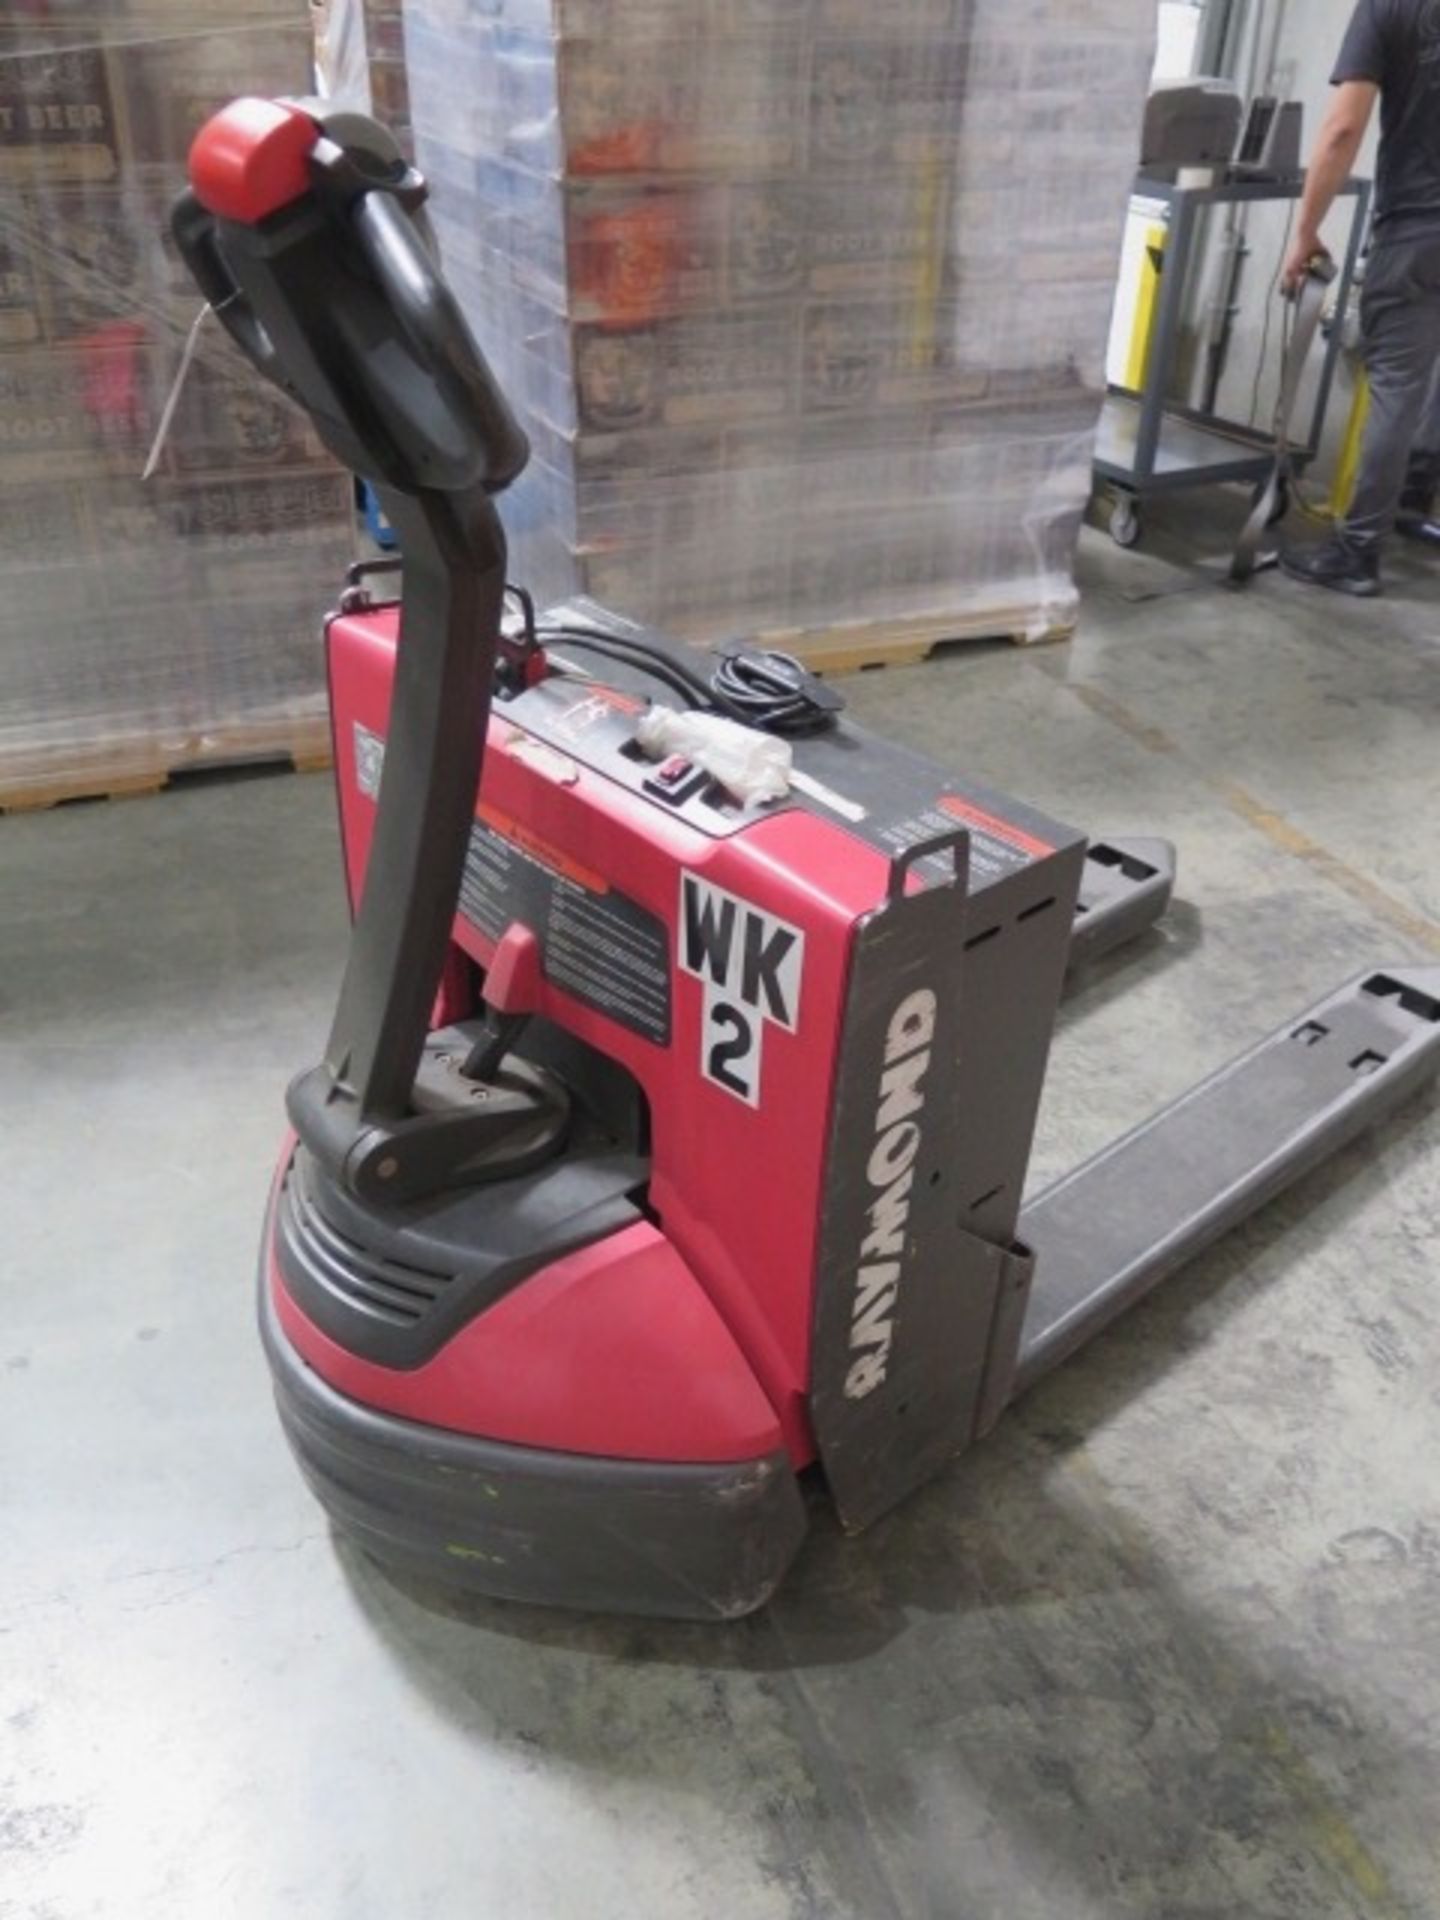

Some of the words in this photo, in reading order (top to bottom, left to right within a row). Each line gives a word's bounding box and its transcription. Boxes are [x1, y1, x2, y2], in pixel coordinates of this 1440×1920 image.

[27, 104, 104, 129] BEER
[684, 876, 797, 1027] WK
[708, 1001, 752, 1099] 2
[843, 988, 938, 1400] RAYMOND
